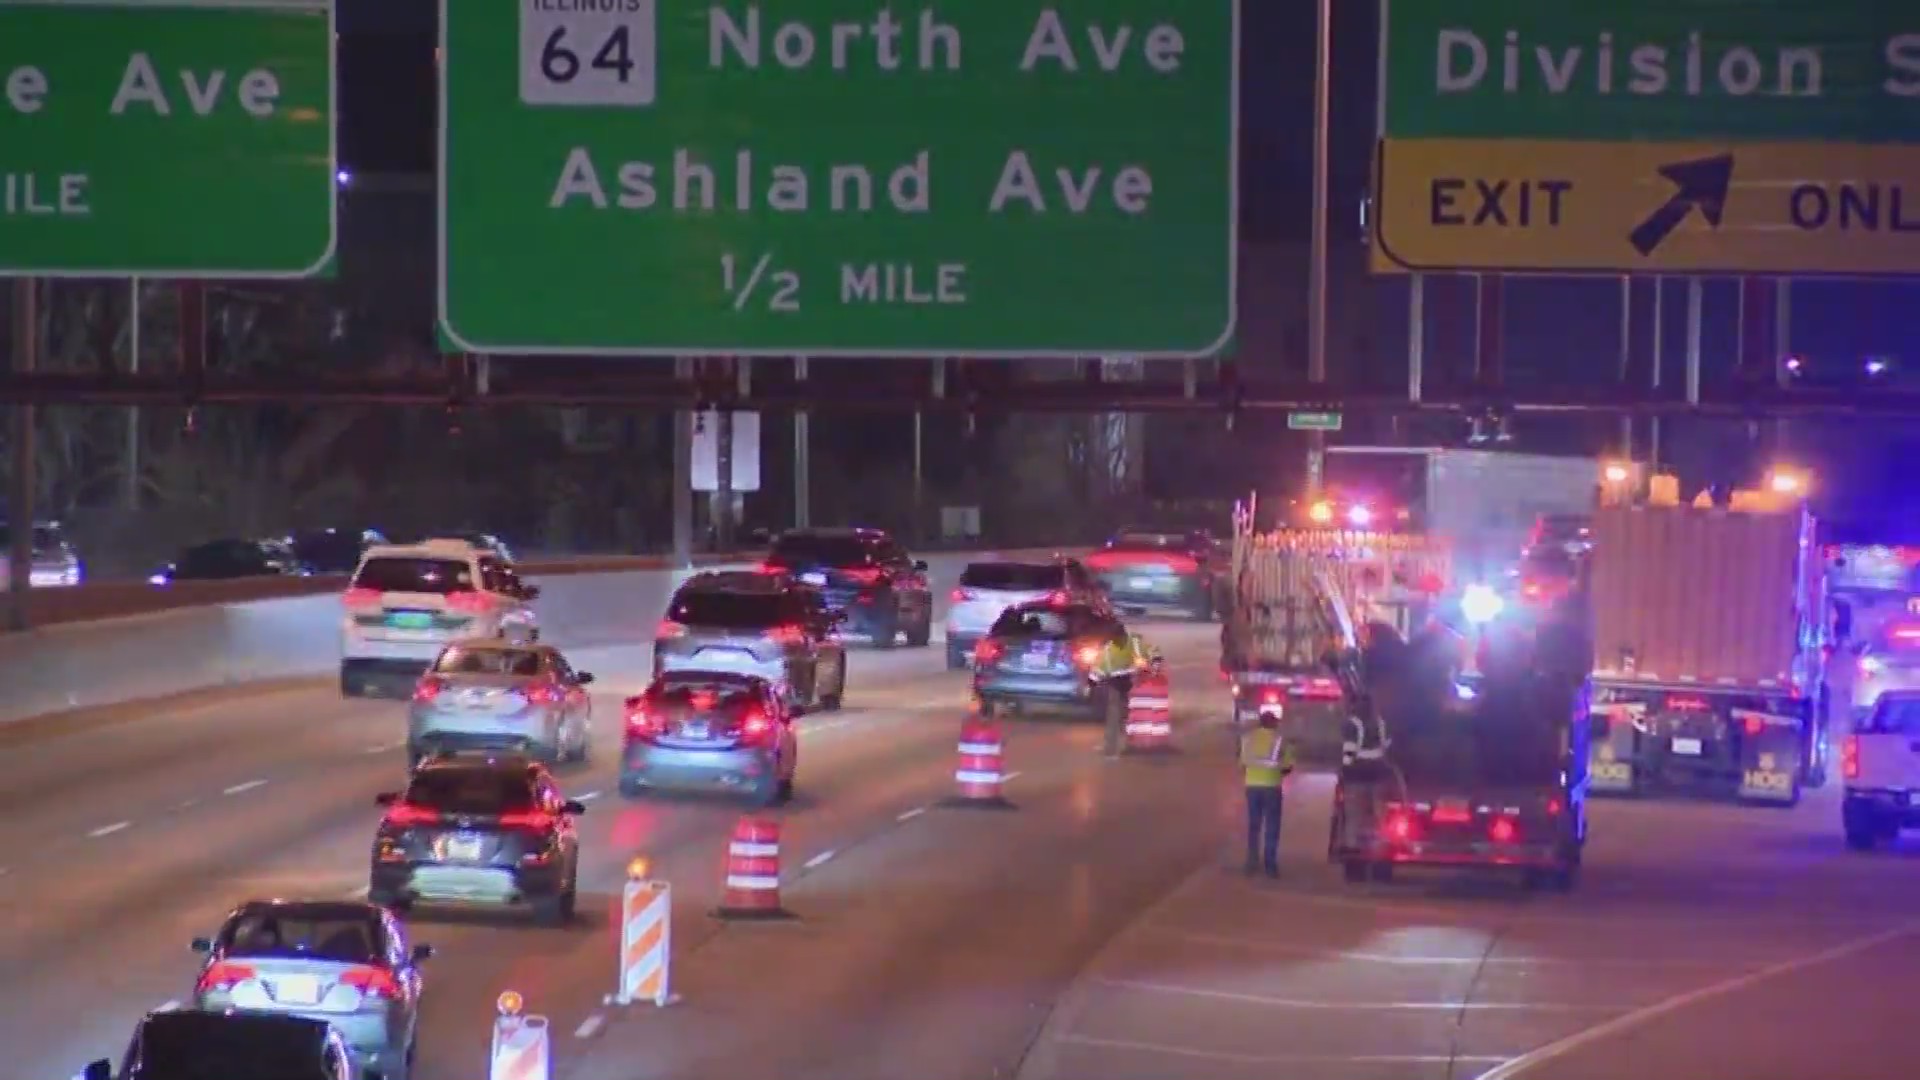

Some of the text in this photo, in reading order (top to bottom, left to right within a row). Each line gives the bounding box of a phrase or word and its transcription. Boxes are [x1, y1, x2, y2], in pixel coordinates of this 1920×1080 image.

[540, 25, 635, 84] 64
[708, 5, 1185, 72] North Ave
[1435, 29, 1823, 96] Division
[110, 52, 281, 117] Ave
[550, 147, 1154, 214] Ashland Ave
[1430, 178, 1573, 227] EXIT
[841, 264, 967, 304] MILE
